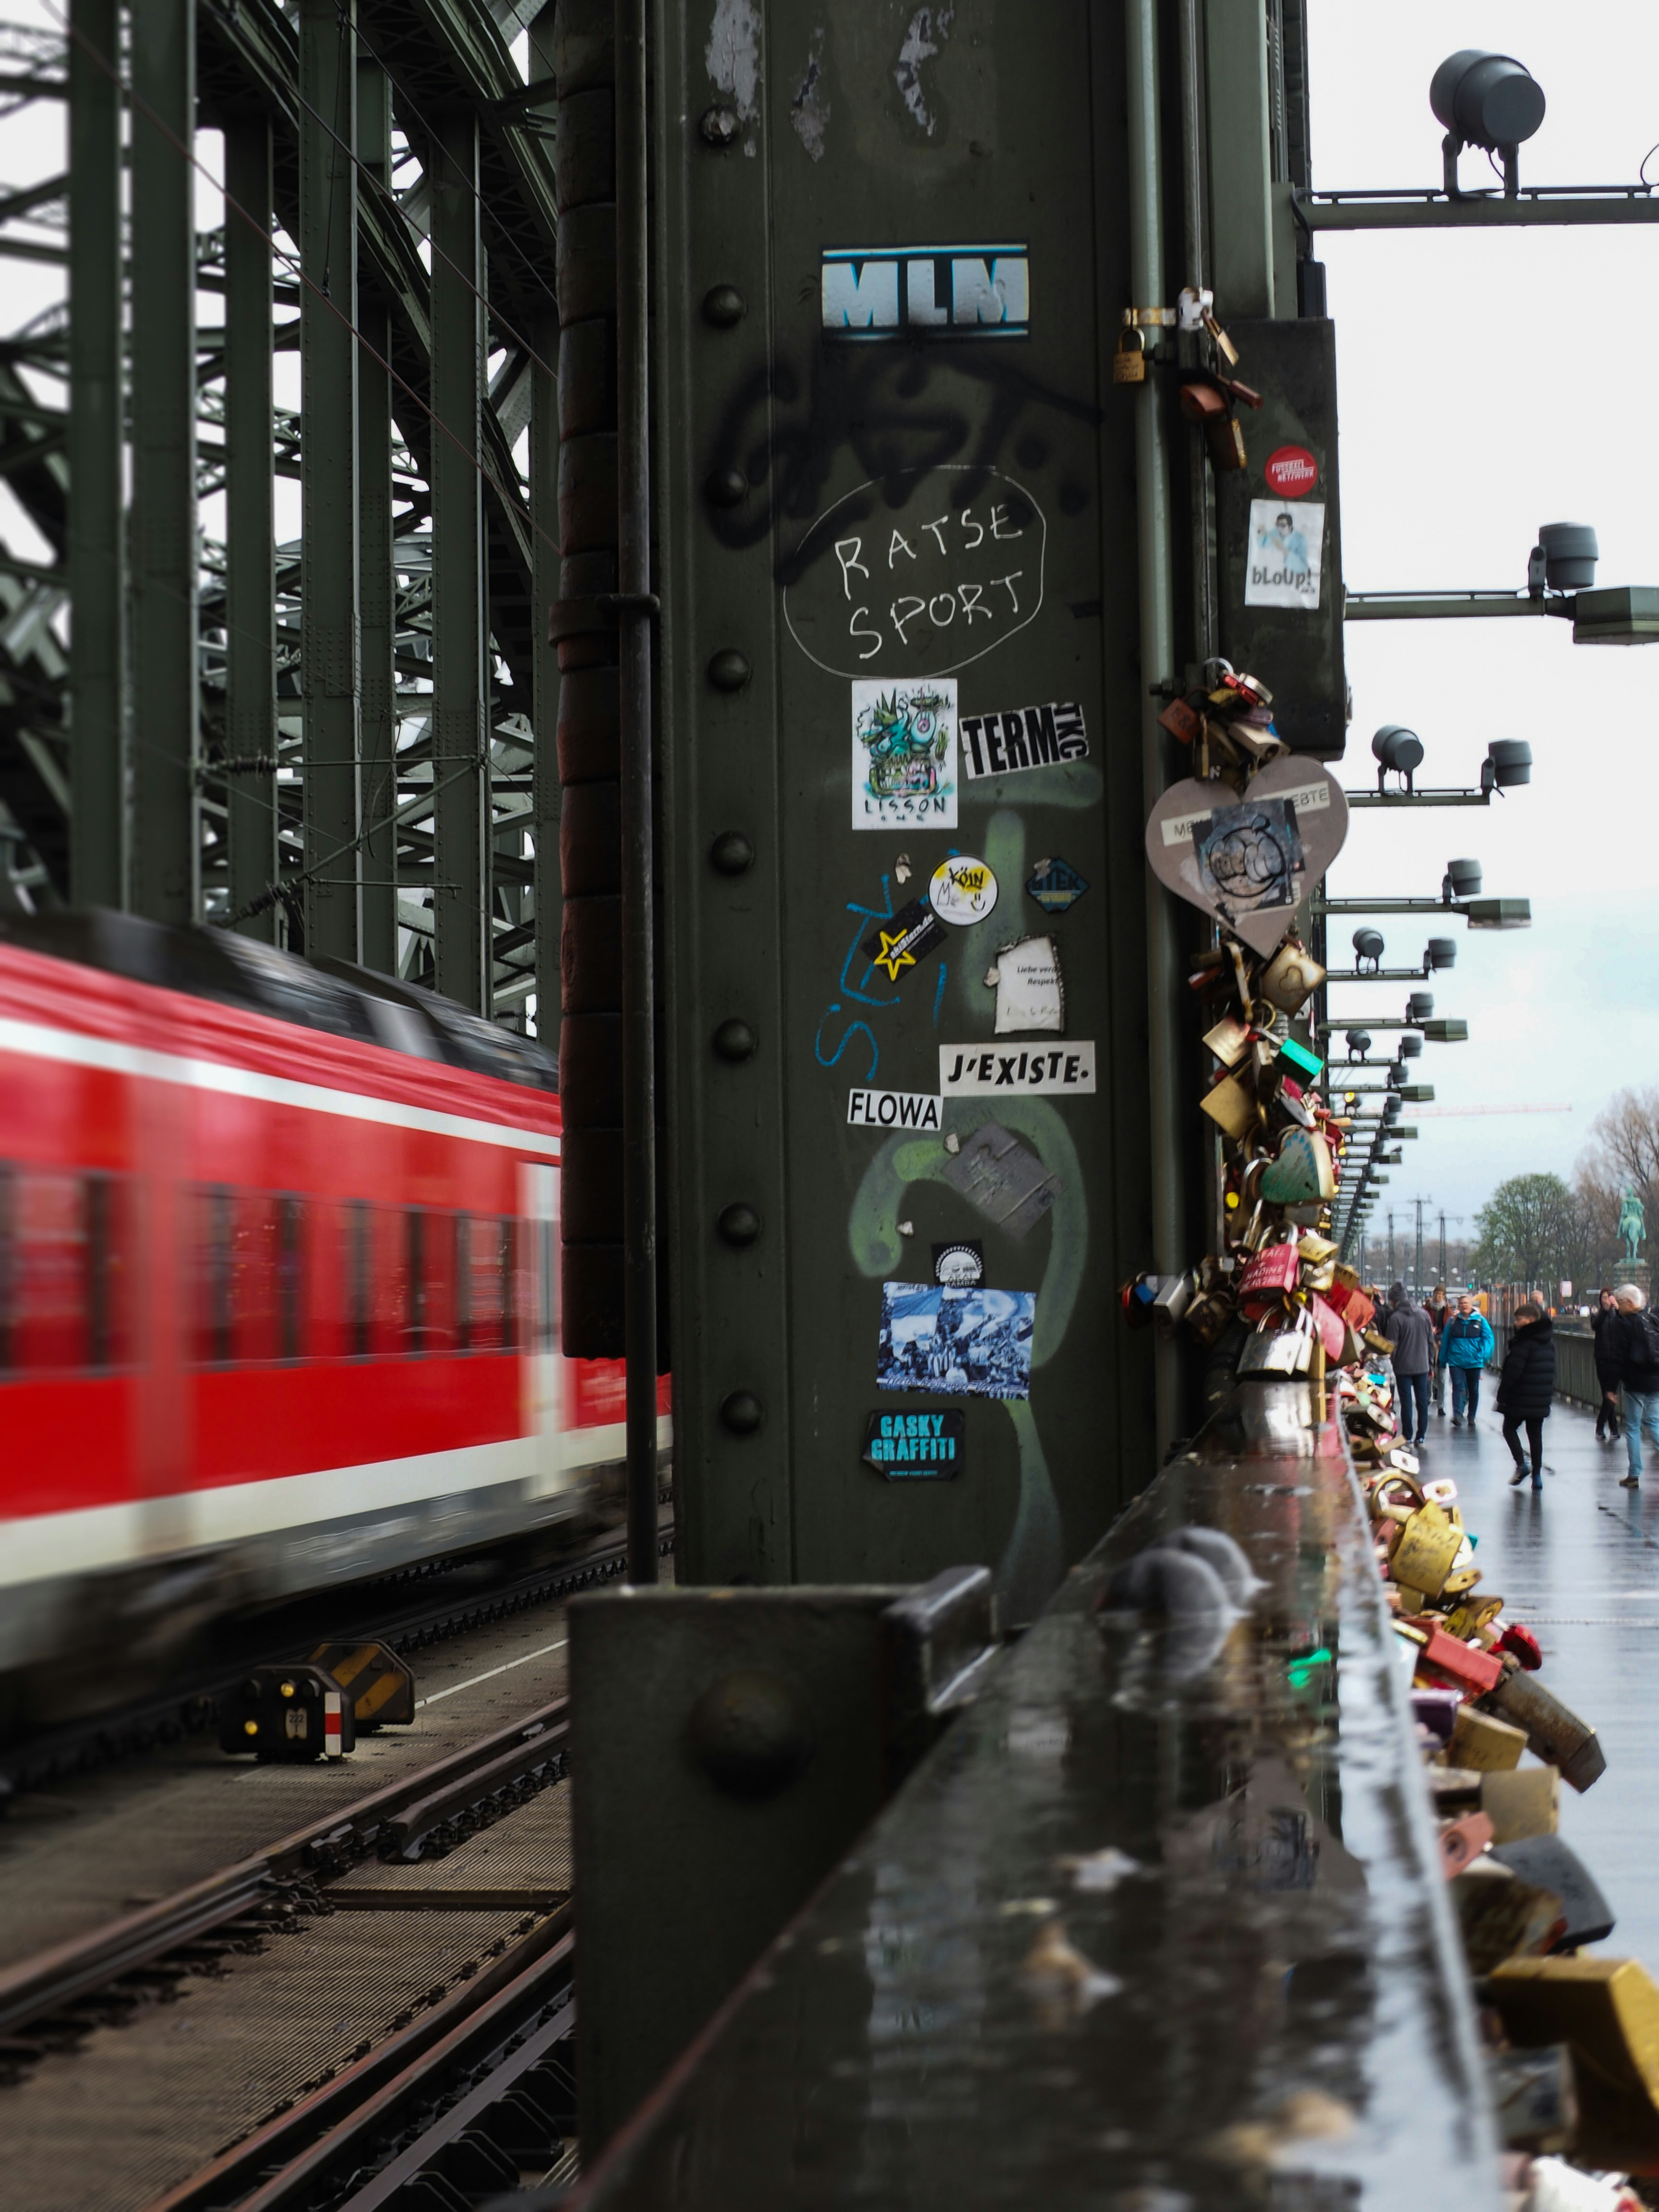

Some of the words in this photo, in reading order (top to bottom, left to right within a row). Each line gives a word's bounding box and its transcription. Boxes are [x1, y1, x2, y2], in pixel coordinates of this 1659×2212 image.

[821, 258, 1029, 328] MLM
[850, 571, 1023, 659] SPORT
[962, 707, 1060, 775] TERM
[865, 796, 945, 814] LISSON
[850, 1093, 939, 1129] FLOWA
[880, 1414, 944, 1438] GASKY
[871, 1437, 956, 1461] GRAFFITI
